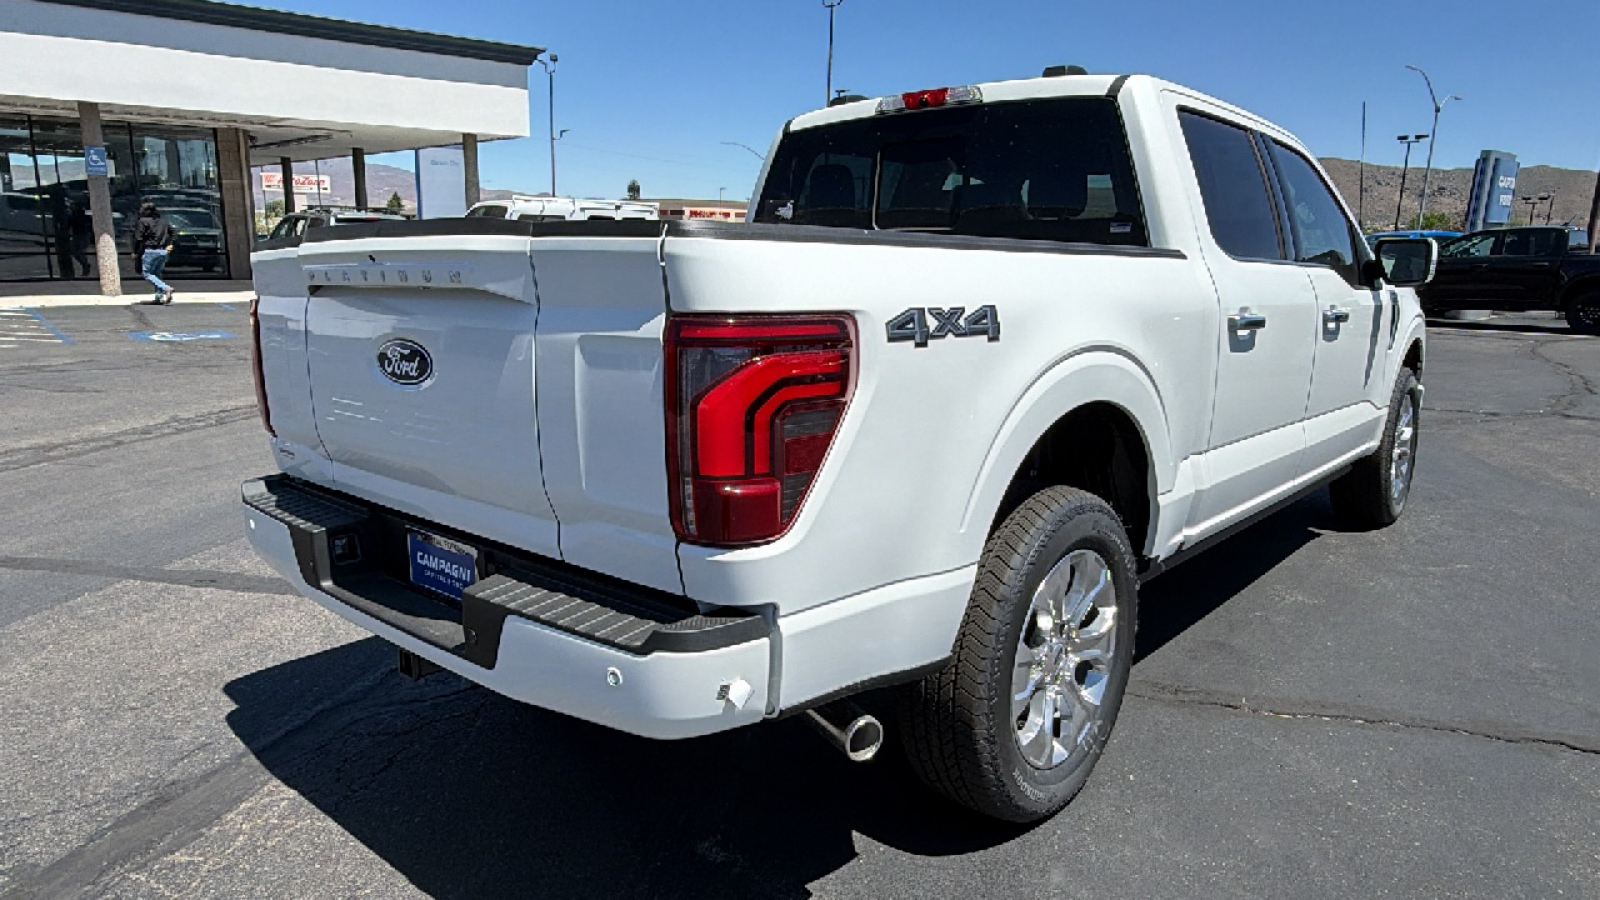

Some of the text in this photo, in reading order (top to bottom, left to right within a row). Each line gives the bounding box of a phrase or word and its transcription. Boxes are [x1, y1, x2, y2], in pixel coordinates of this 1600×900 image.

[308, 270, 462, 284] PLATINUM
[385, 347, 420, 377] Ford
[416, 551, 471, 582] CAMPAGNI
